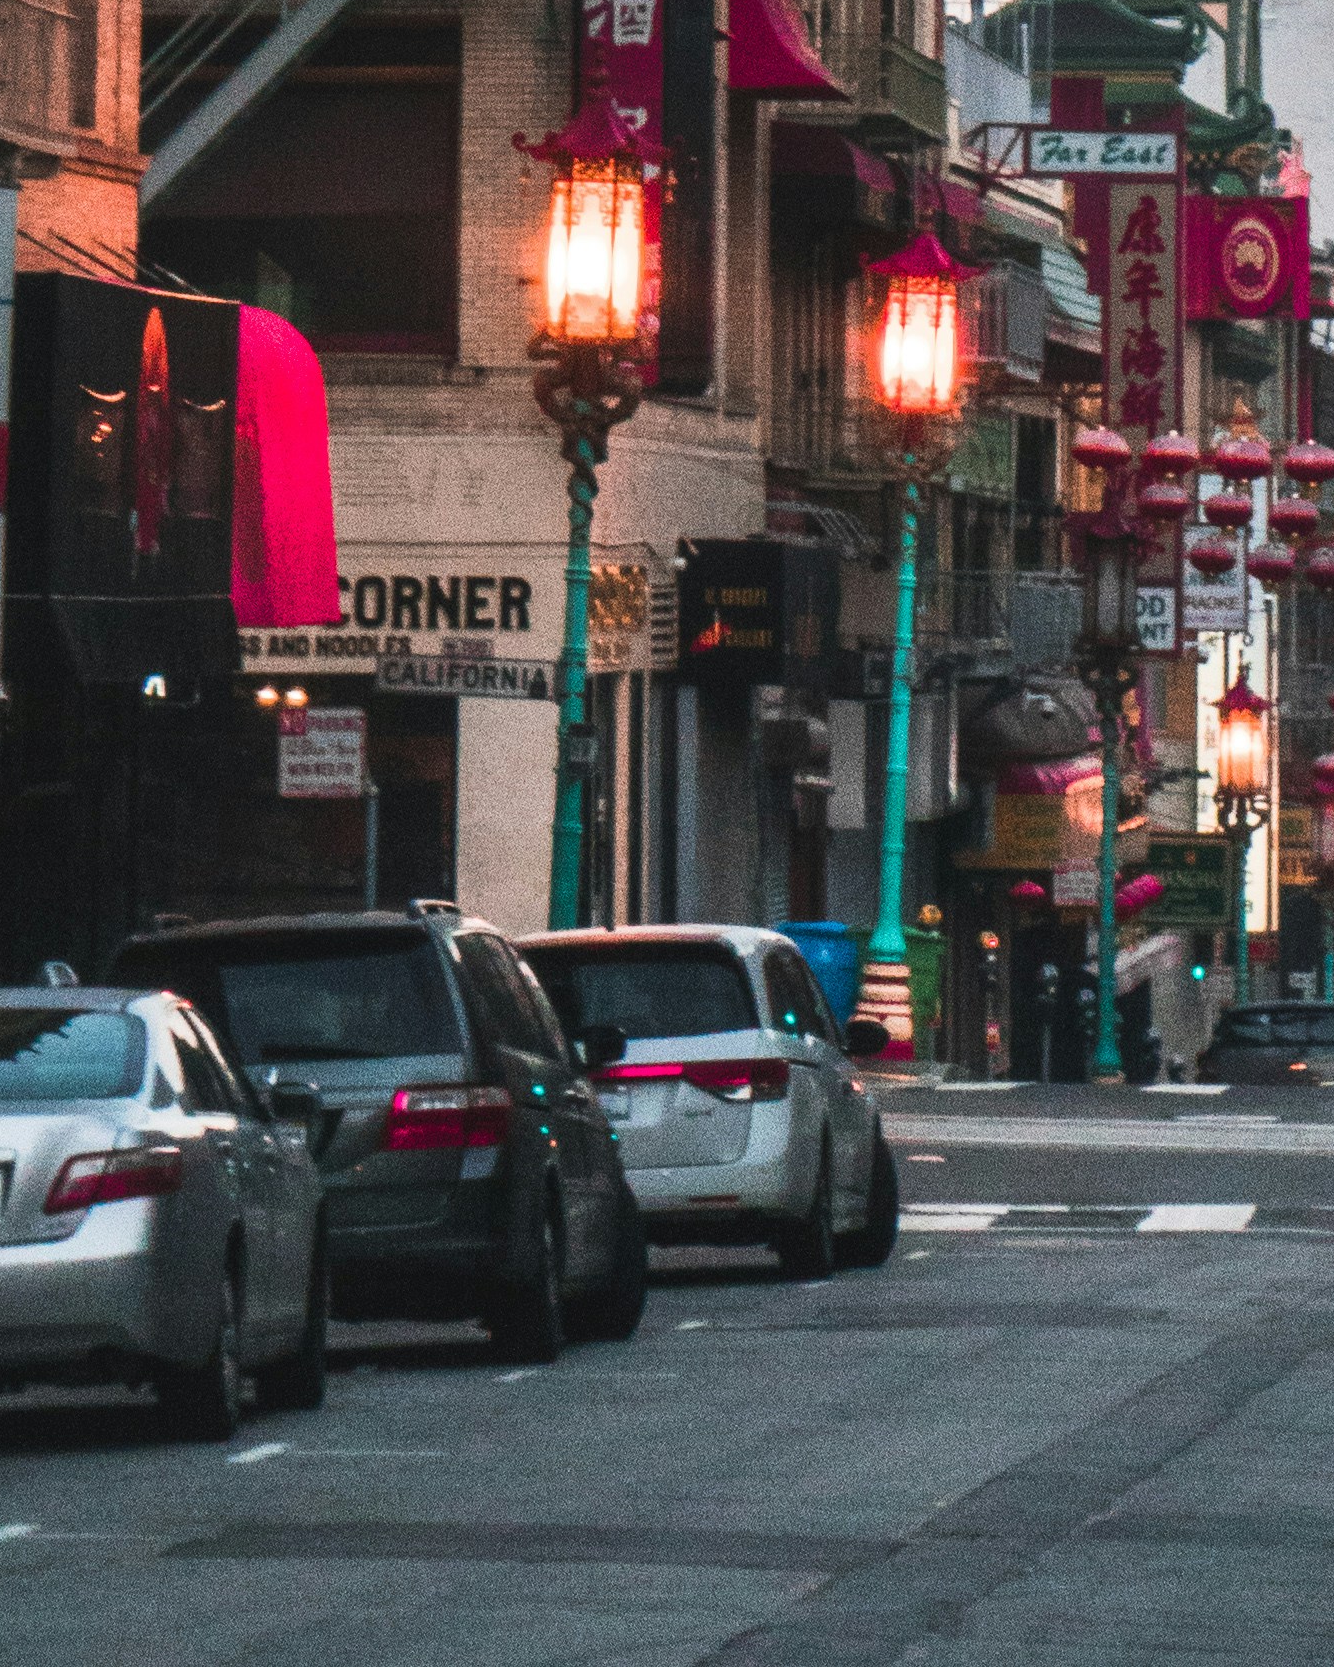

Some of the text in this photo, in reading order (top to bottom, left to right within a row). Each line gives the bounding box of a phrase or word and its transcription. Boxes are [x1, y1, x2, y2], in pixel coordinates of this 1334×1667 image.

[1039, 134, 1169, 165] Far East
[266, 635, 309, 656] AND
[316, 636, 412, 657] NOODLES
[382, 660, 547, 694] CALIFORNIA
